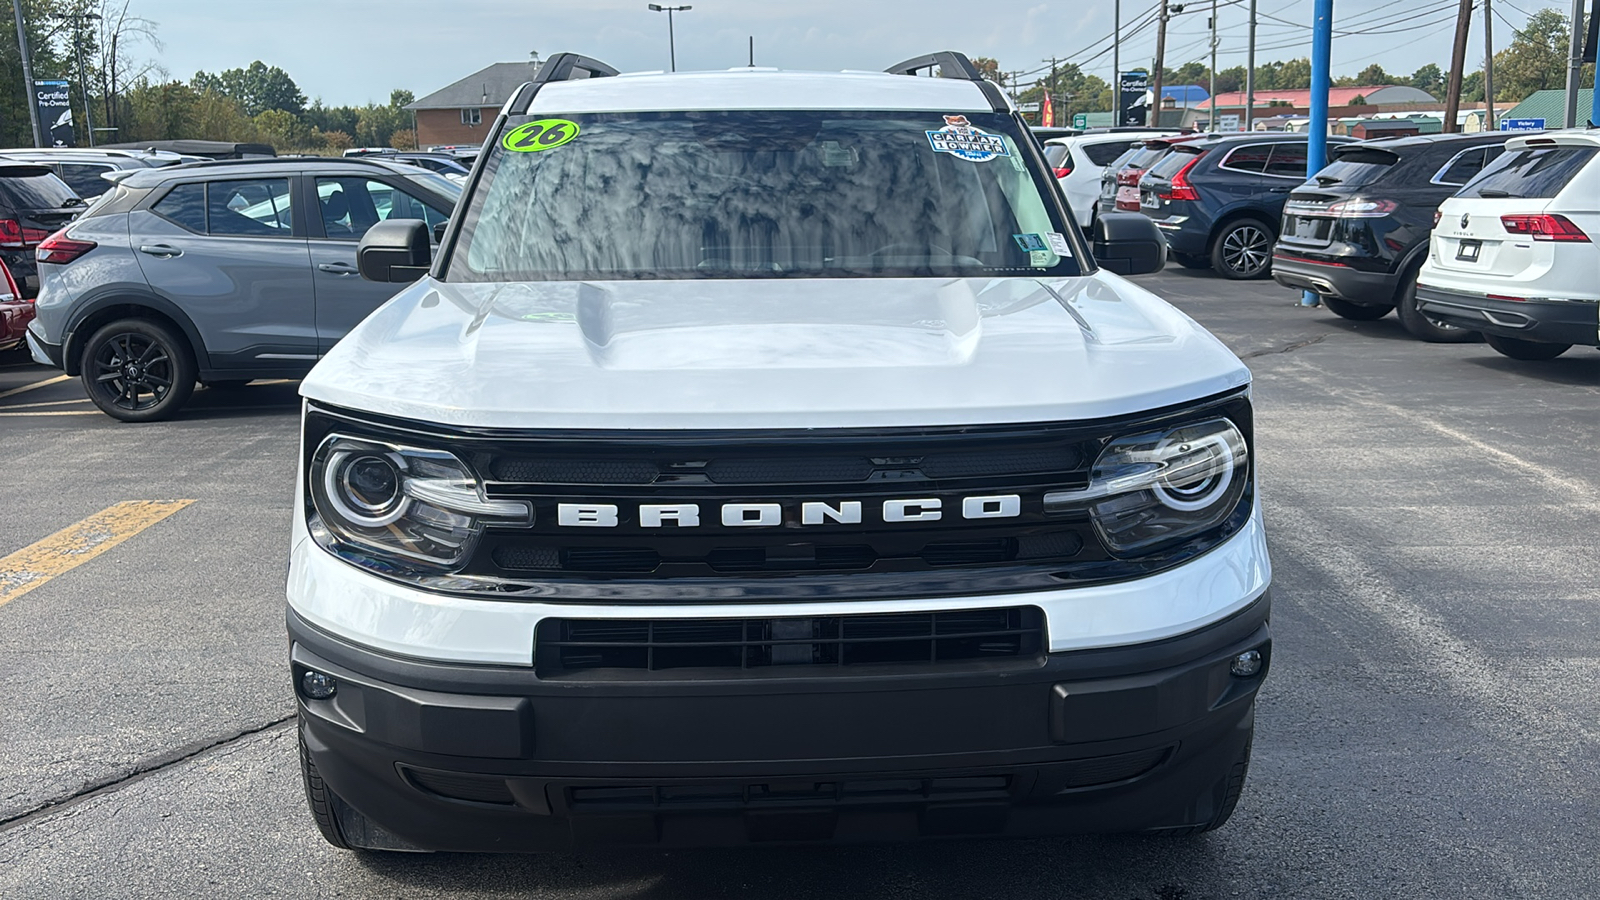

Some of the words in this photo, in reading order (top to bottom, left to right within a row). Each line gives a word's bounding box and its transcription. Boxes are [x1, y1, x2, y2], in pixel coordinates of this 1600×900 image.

[37, 91, 69, 100] Certified
[514, 123, 569, 148] 26
[933, 133, 1001, 145] CARFAX
[948, 142, 1004, 153] OWNER
[557, 495, 1021, 528] BRONCO
